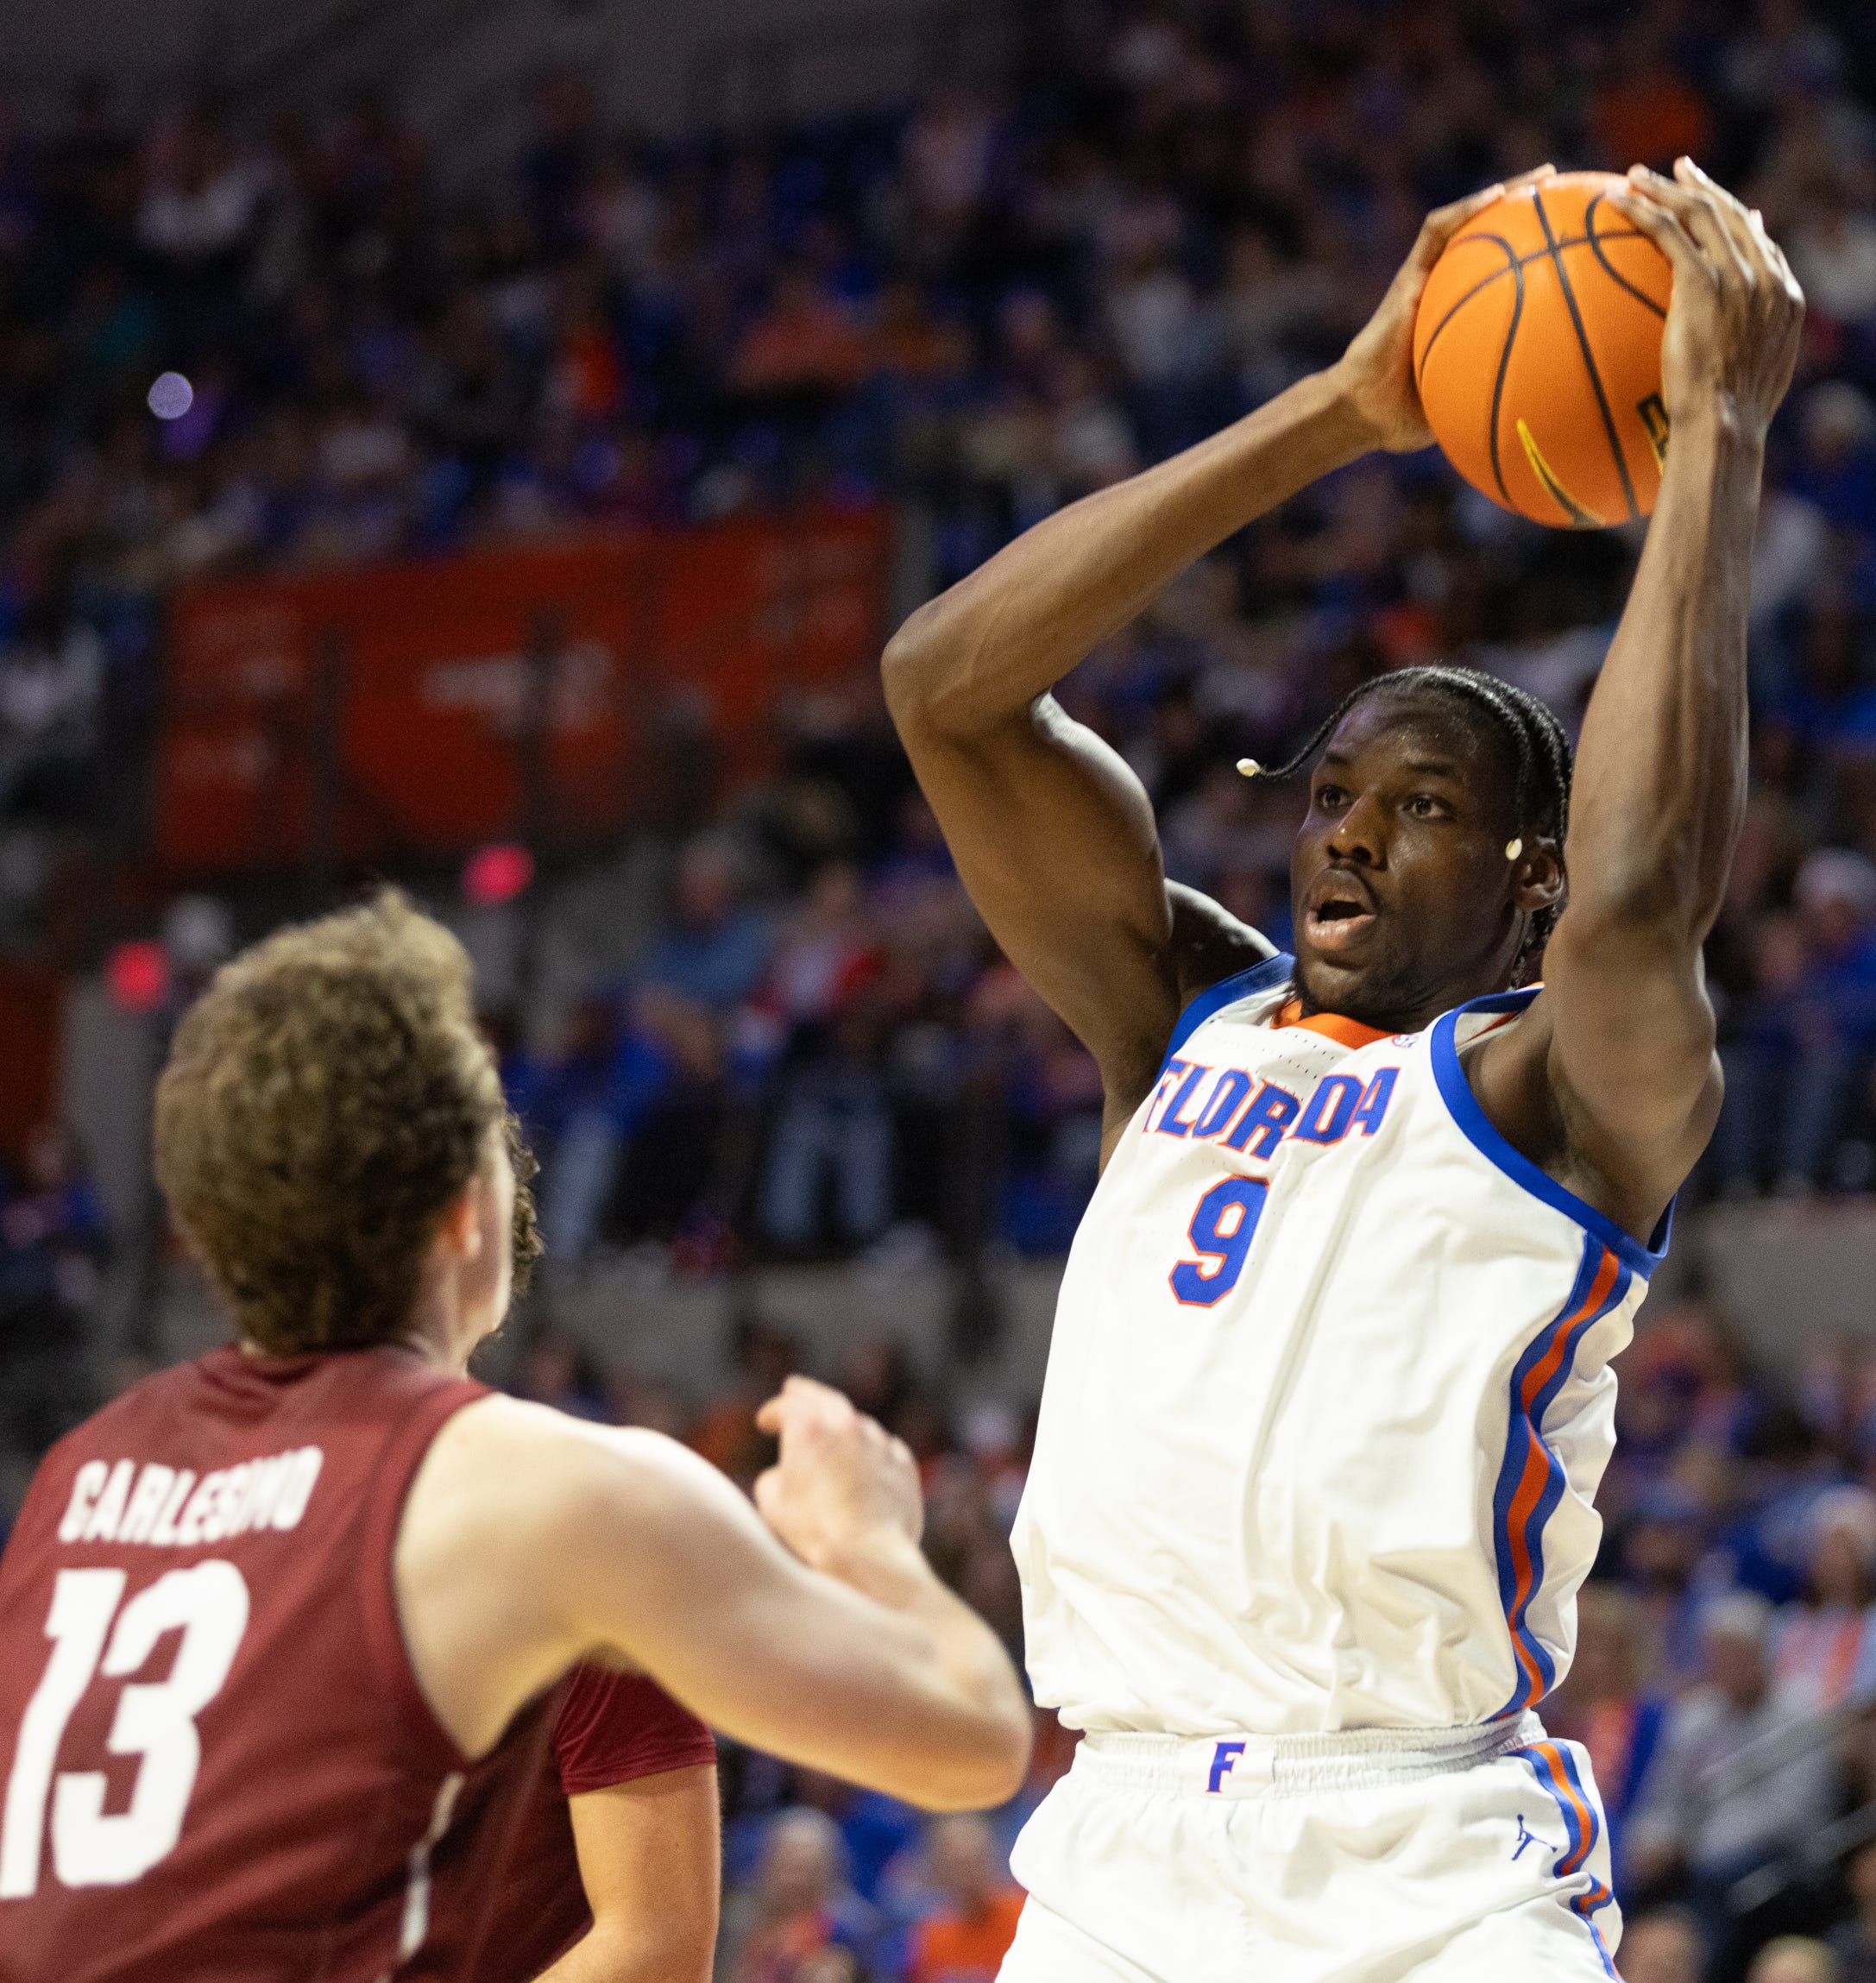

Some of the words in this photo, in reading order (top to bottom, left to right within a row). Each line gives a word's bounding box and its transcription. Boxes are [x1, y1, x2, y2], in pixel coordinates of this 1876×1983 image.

[1168, 1174, 1269, 1307] 9
[0, 1558, 249, 1899] 13
[1206, 1741, 1247, 1793] F
